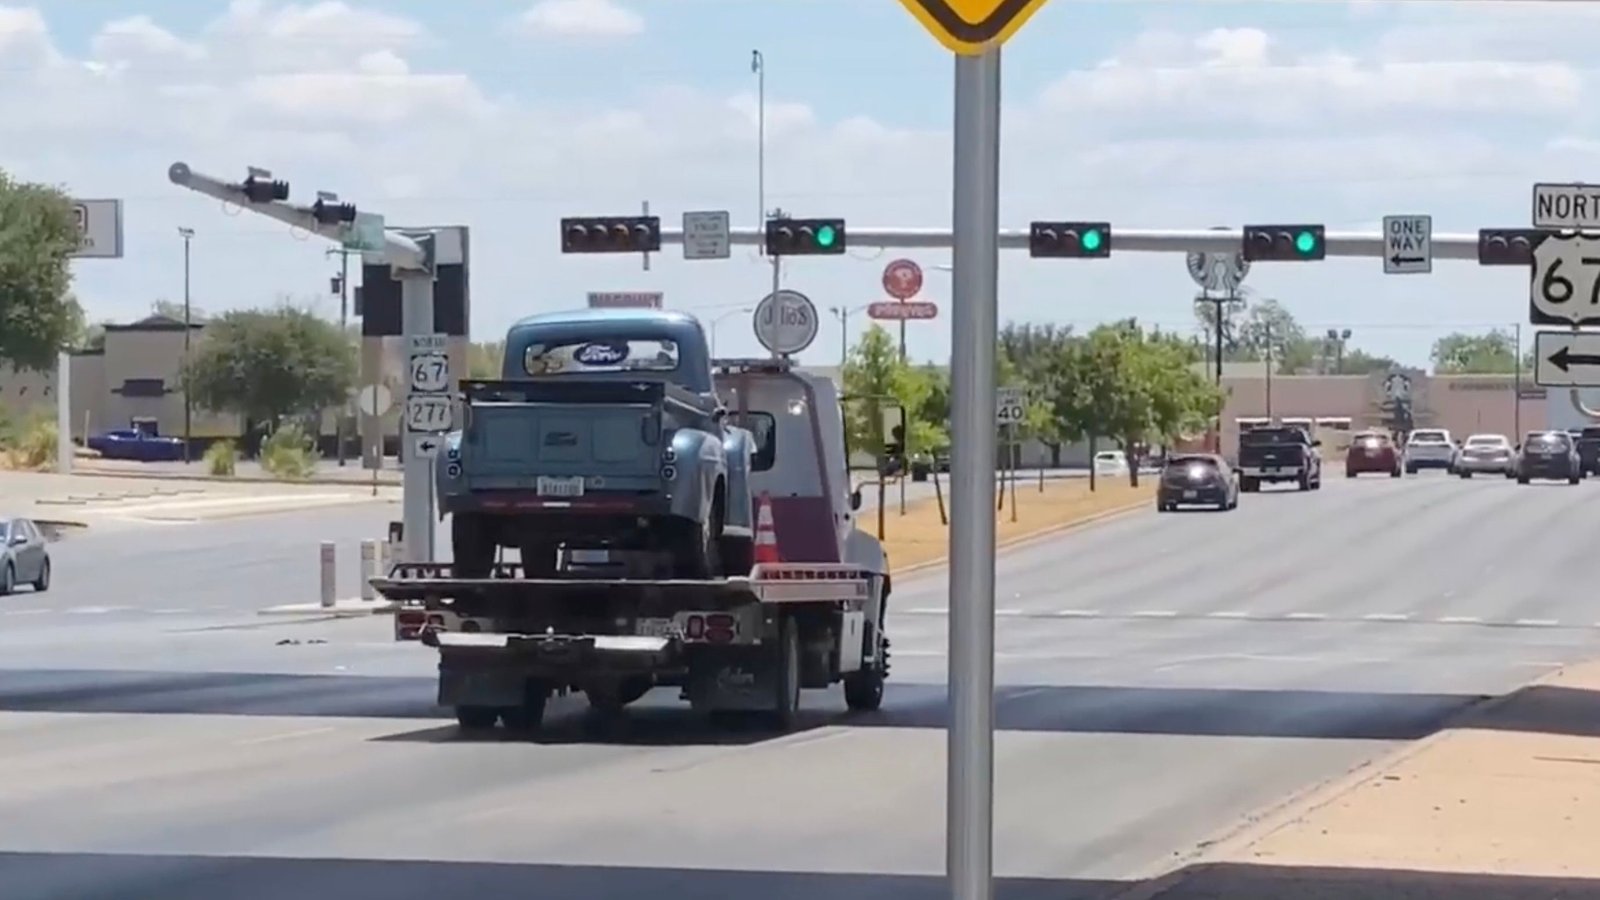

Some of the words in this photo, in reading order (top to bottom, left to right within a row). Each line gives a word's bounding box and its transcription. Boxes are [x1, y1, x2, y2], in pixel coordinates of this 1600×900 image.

[1391, 220, 1425, 234] ONE
[1391, 236, 1425, 250] WAY
[1542, 256, 1600, 305] 67
[581, 344, 622, 361] Ford
[416, 362, 443, 382] 67
[413, 403, 446, 422] 277
[998, 406, 1023, 420] 40
